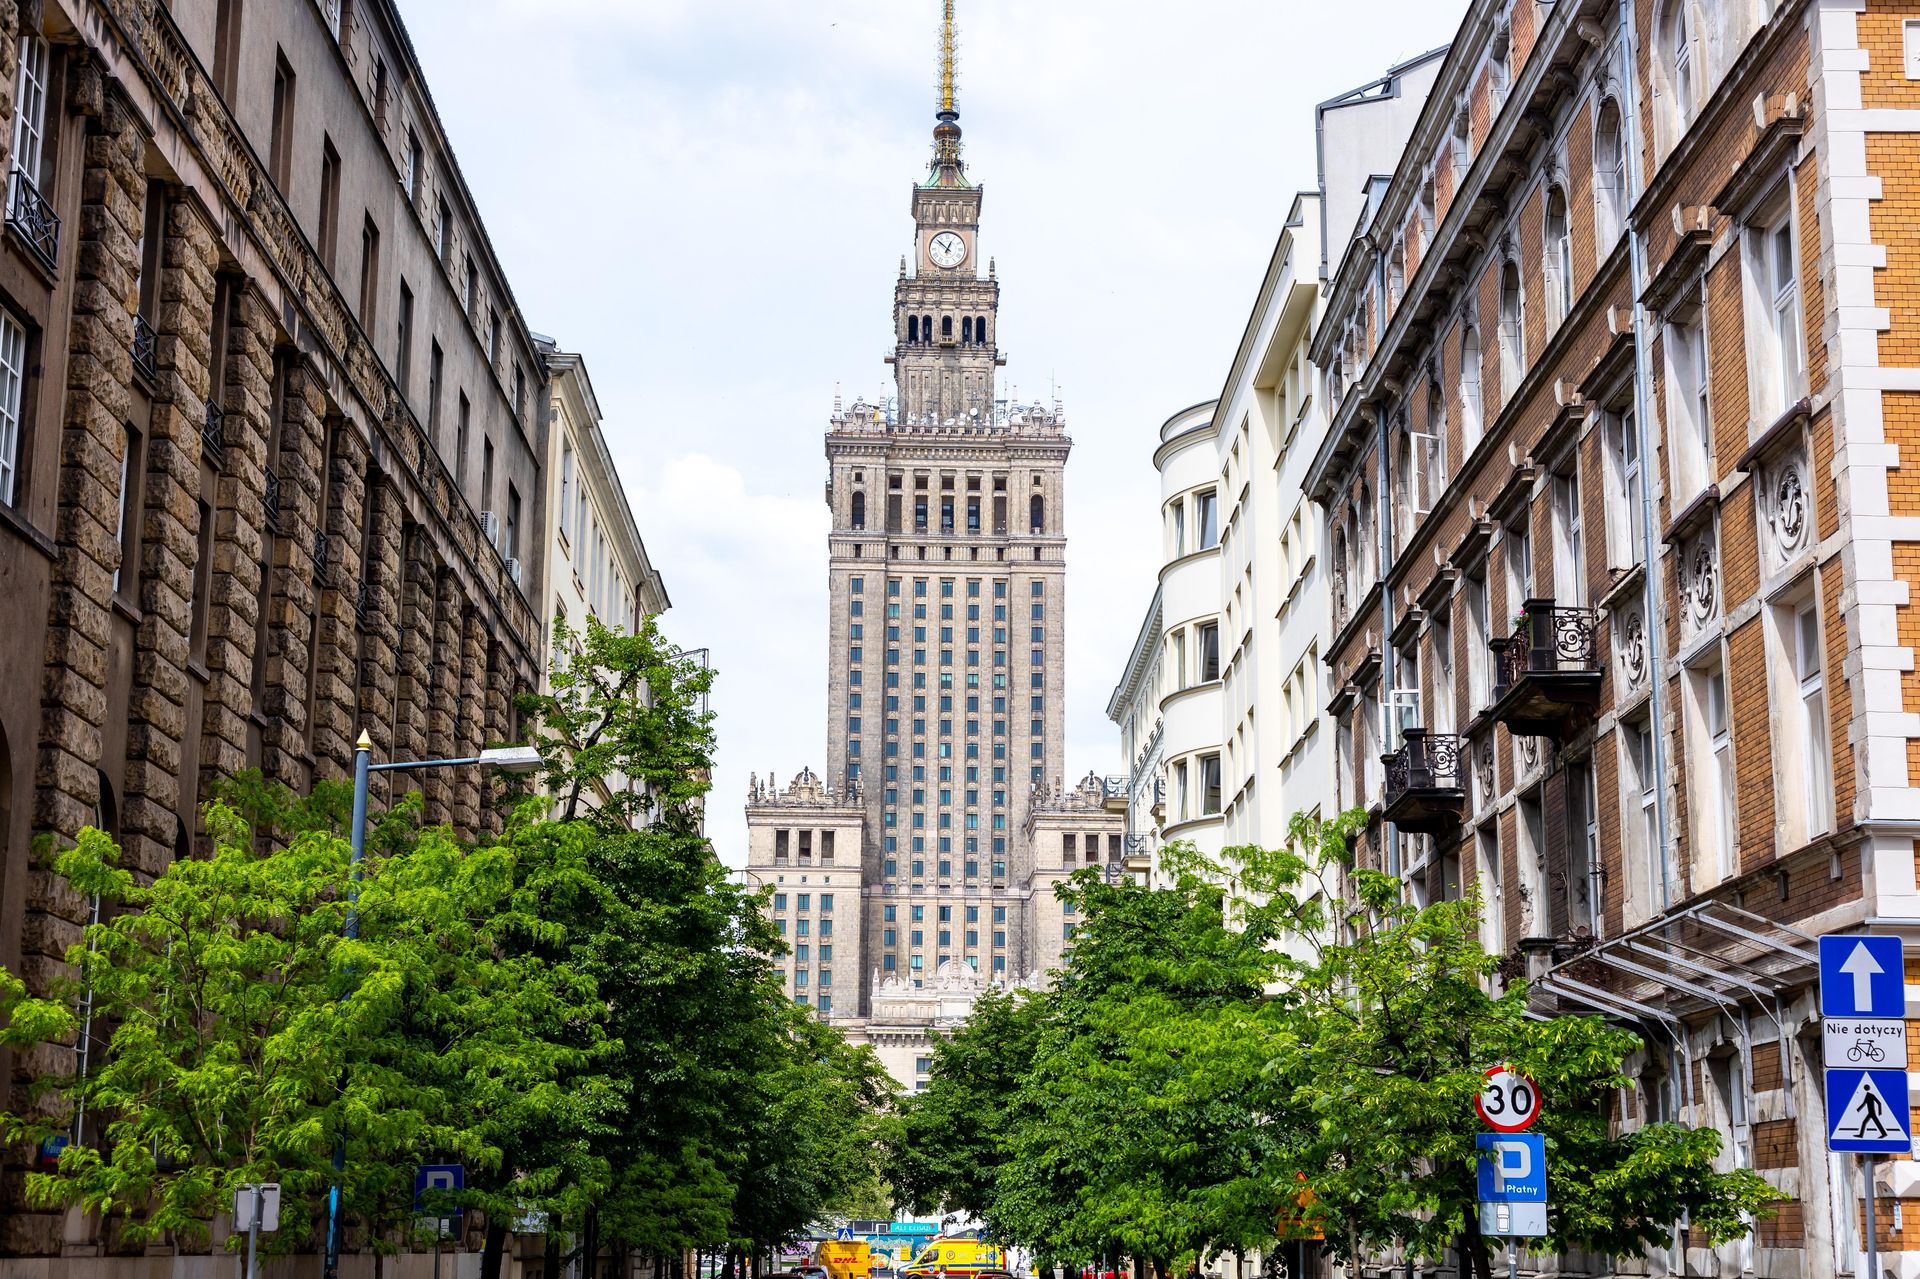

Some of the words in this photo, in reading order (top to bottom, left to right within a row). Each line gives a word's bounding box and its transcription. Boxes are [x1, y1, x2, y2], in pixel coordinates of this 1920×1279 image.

[1827, 1023, 1848, 1034] Nie
[1854, 1023, 1902, 1038] dotyczy
[1485, 1085, 1532, 1116] 30
[1493, 1141, 1532, 1193] P
[1506, 1184, 1538, 1196] Płatny
